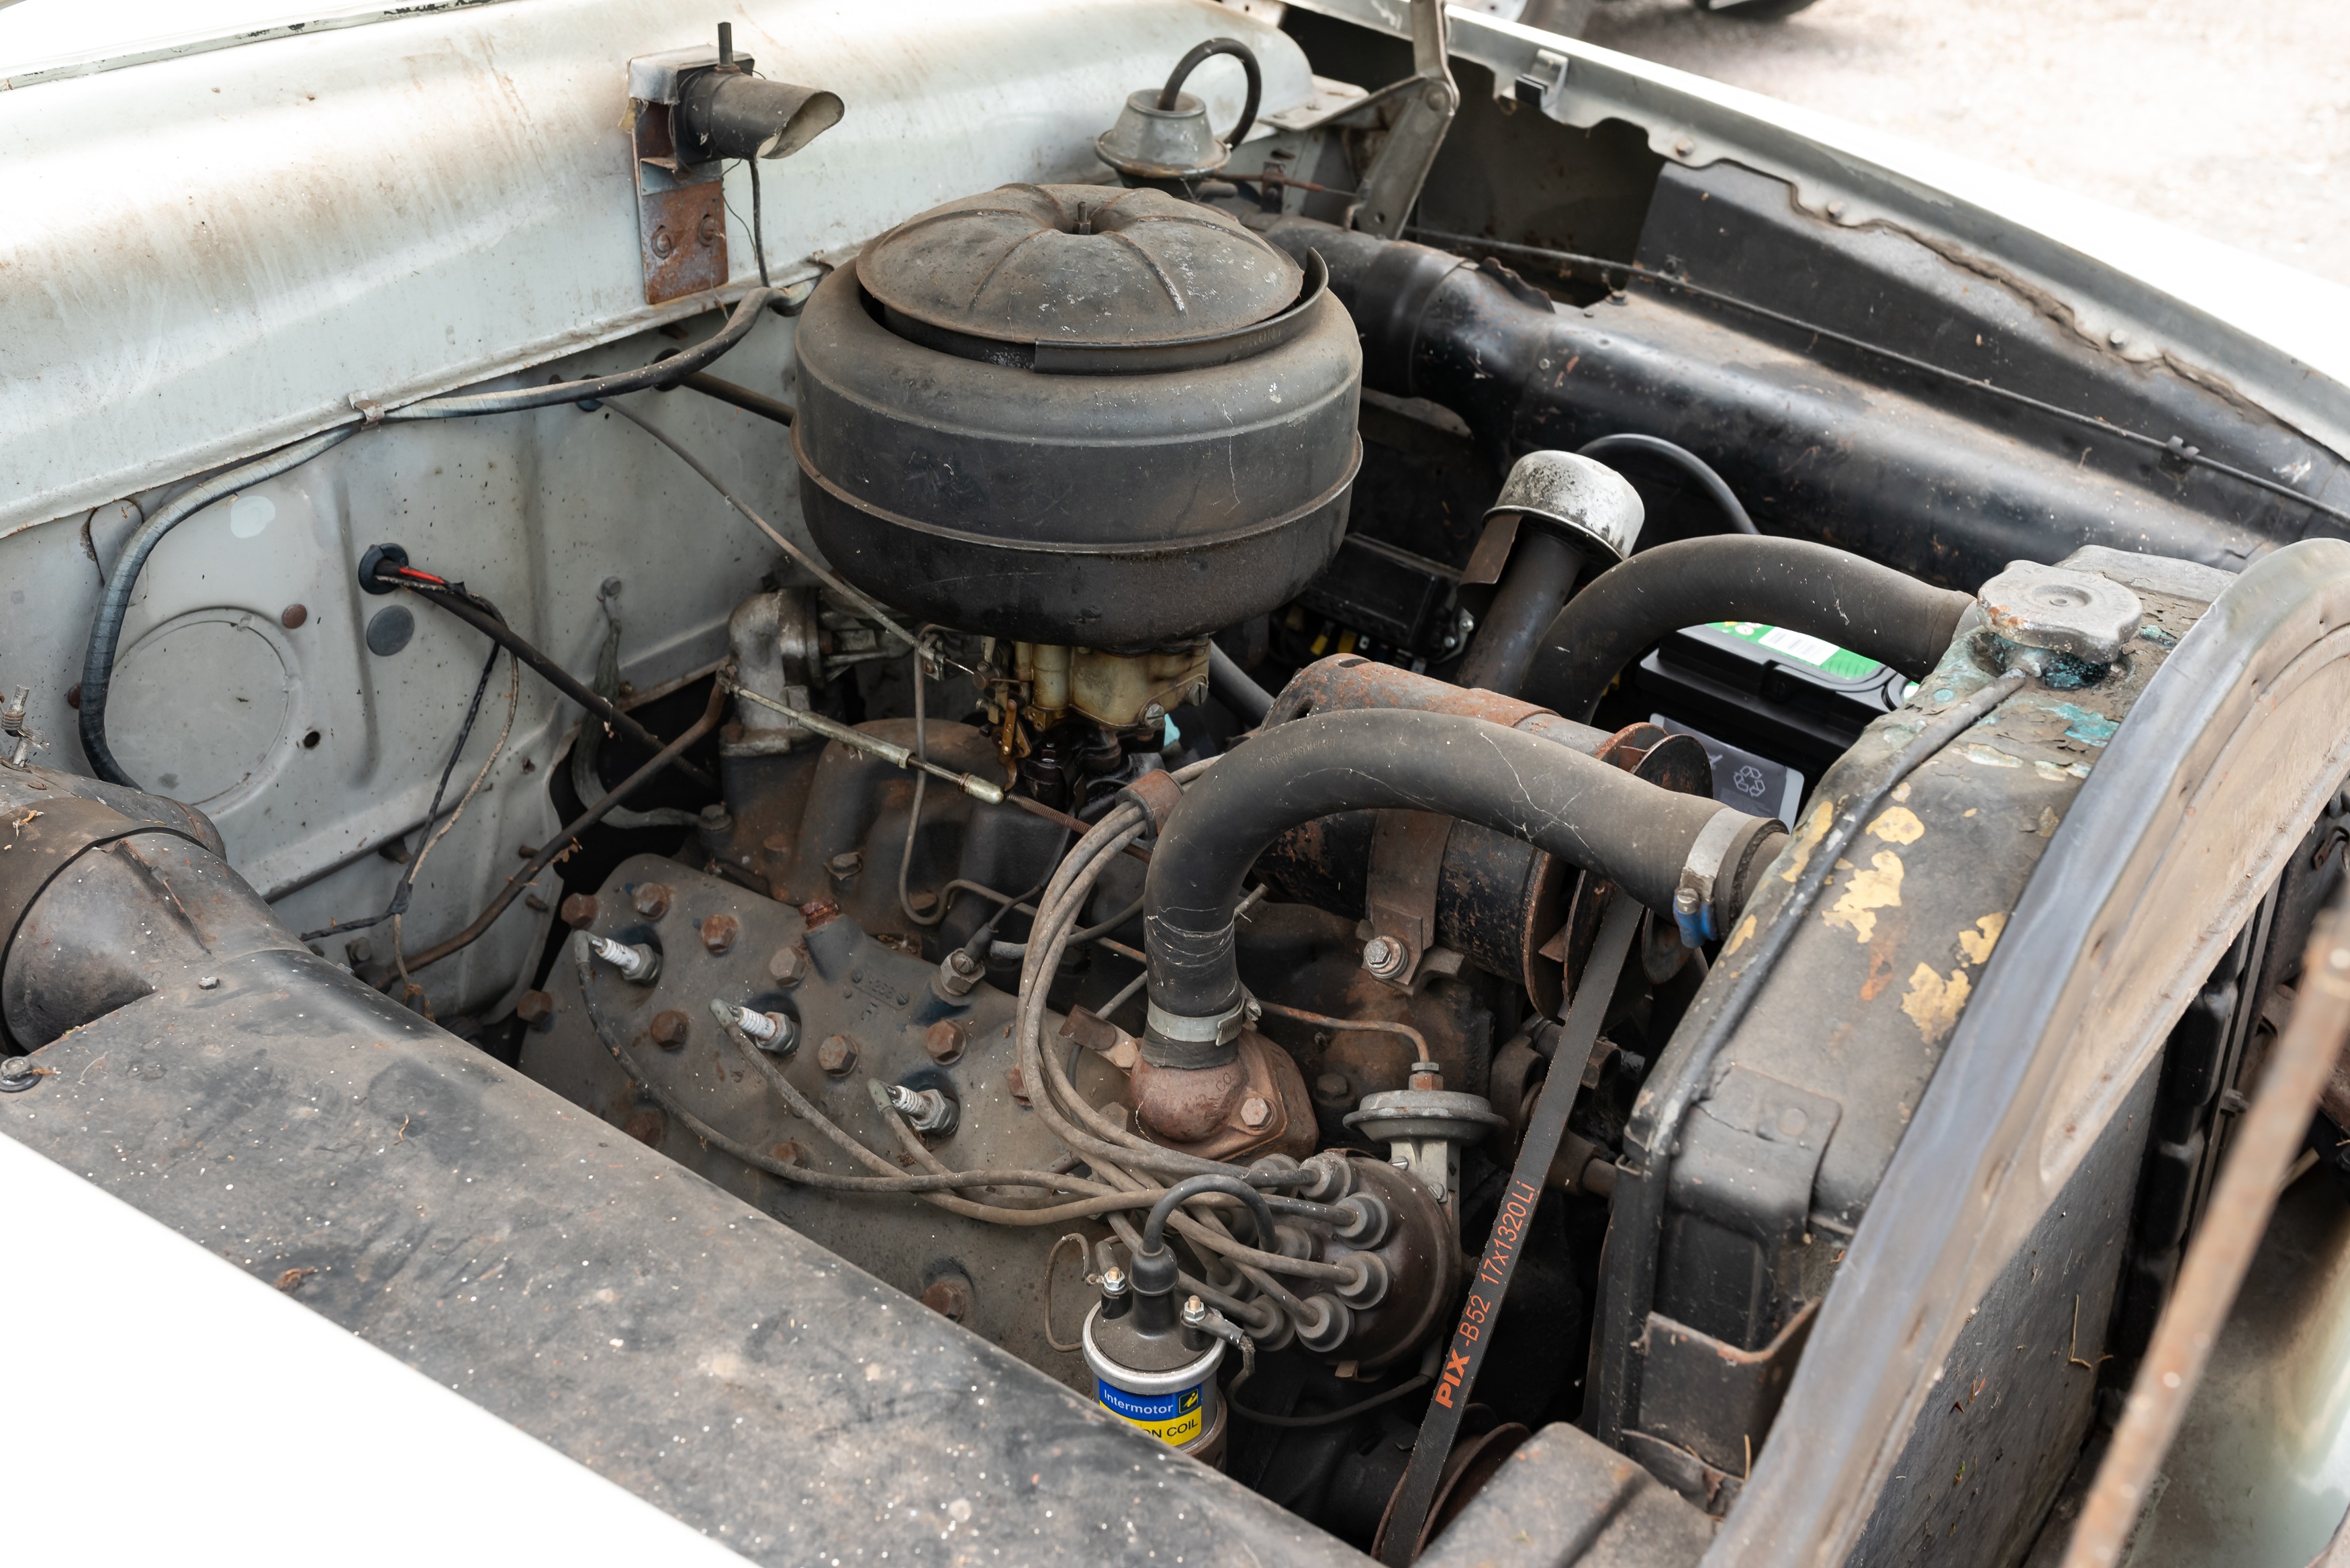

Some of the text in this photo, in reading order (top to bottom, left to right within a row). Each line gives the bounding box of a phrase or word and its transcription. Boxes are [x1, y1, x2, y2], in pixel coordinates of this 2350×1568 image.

[1436, 1349, 1470, 1408] PIX
[1481, 1180, 1536, 1284] 17x1320Li
[1104, 1389, 1174, 1414] Intermotor
[1167, 1419, 1198, 1436] COIL
